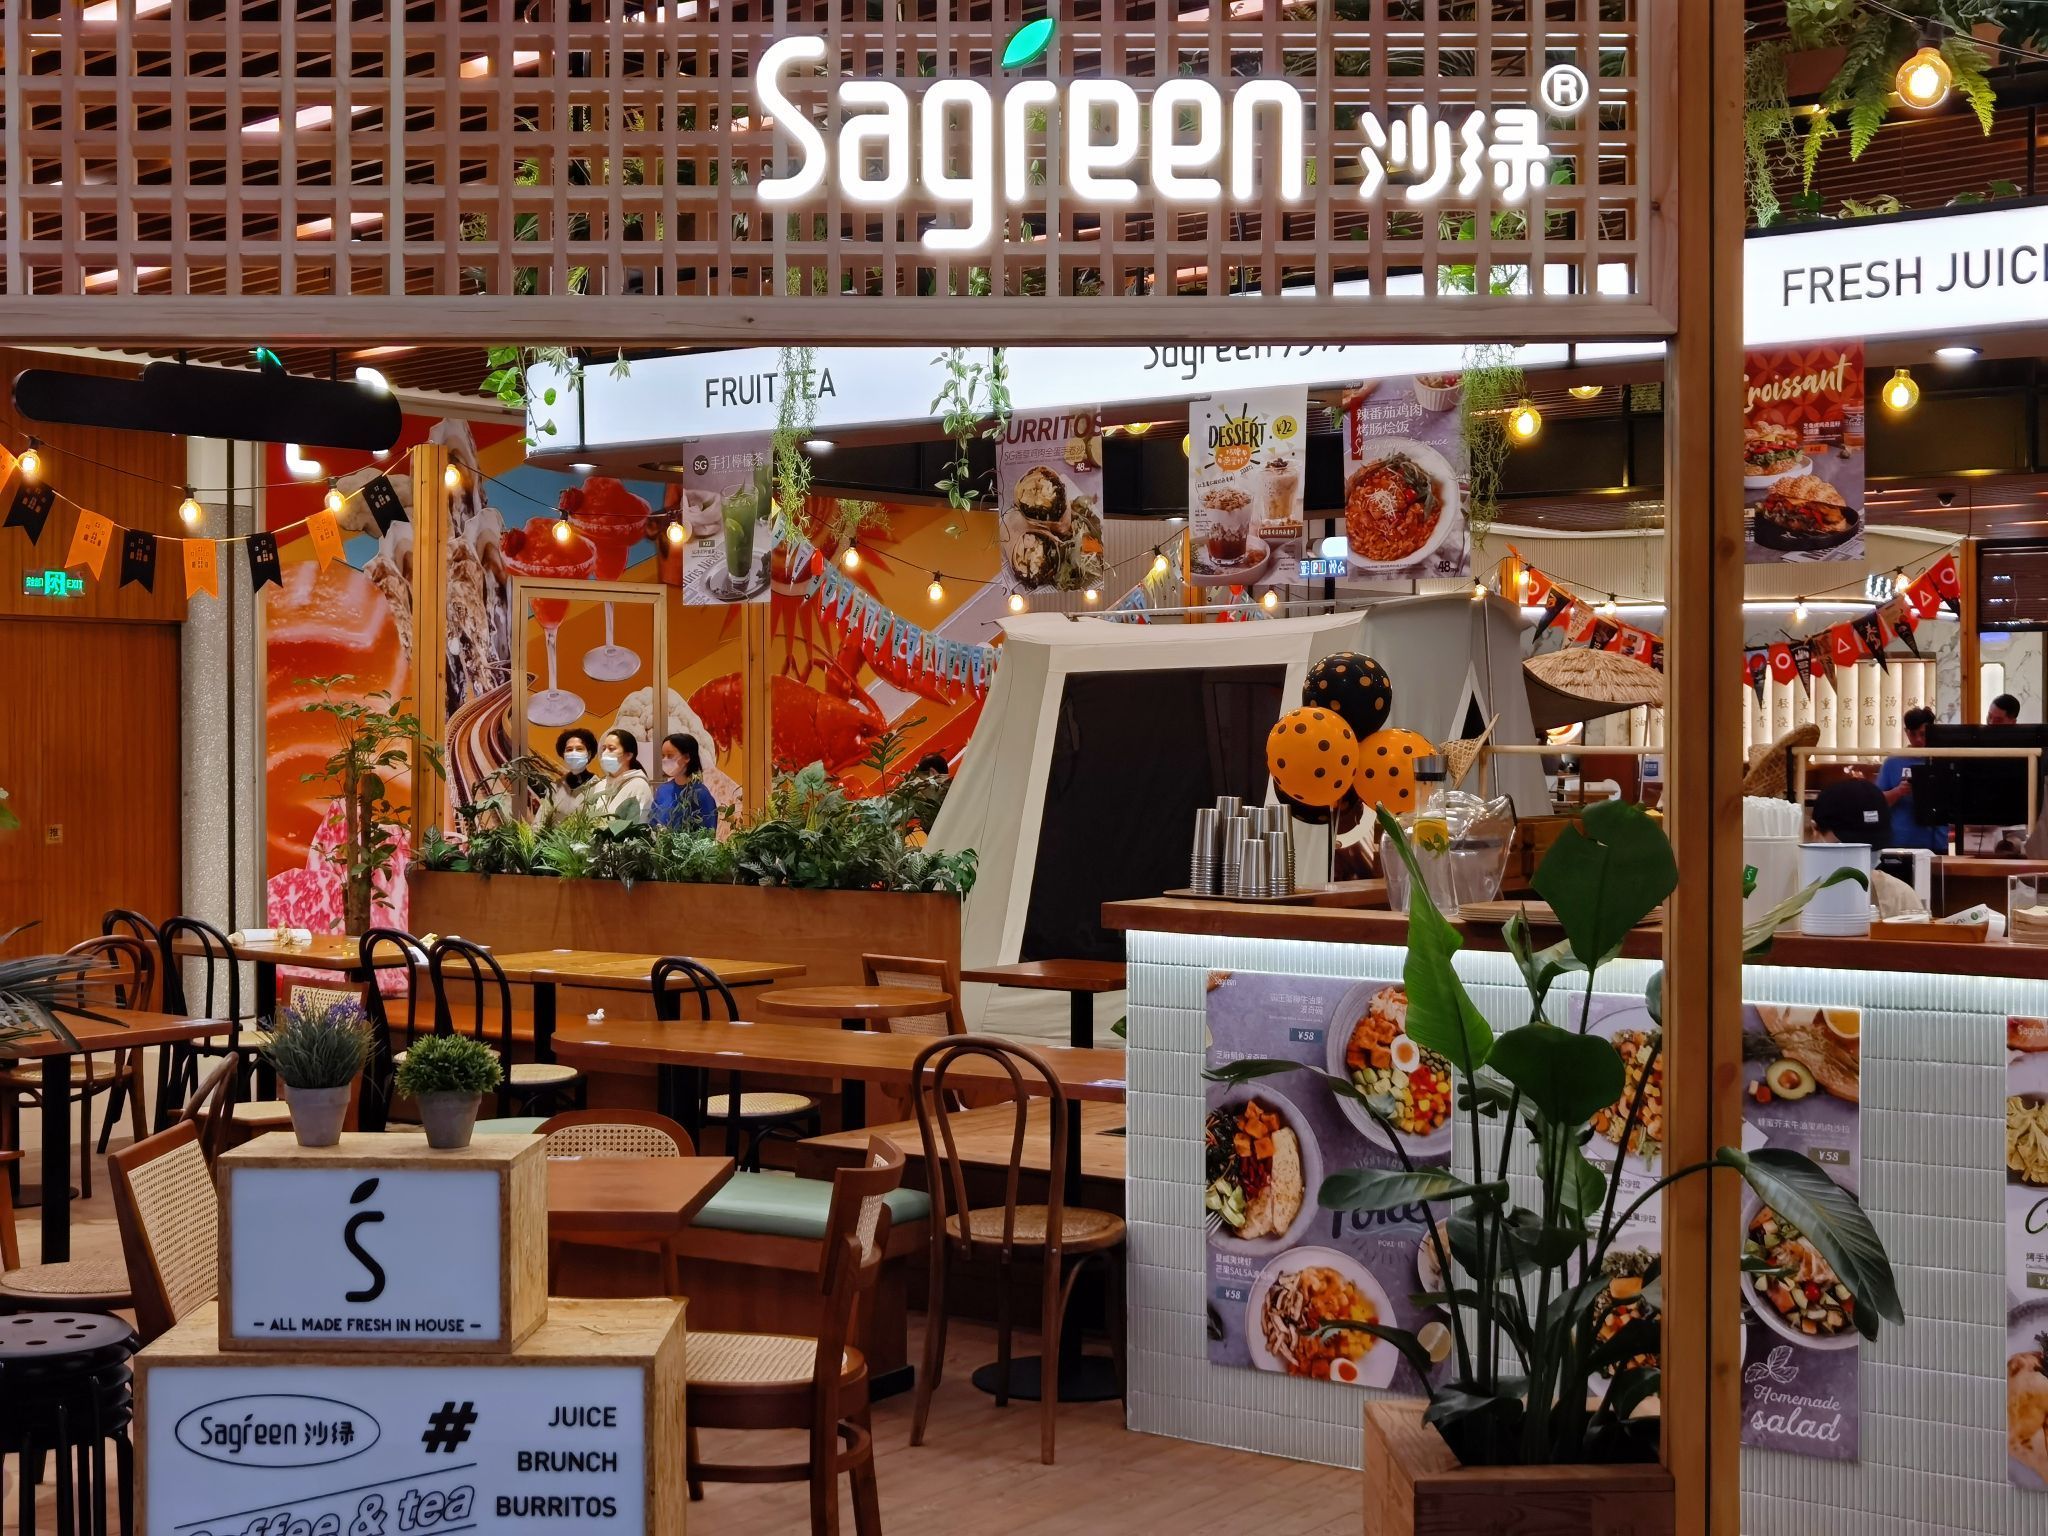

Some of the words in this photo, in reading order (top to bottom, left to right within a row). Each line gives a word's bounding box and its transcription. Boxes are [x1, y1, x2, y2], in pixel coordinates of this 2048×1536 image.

[757, 36, 1304, 250] Sagreen
[1359, 104, 1551, 200] 沙绿
[1783, 256, 1921, 307] FRESH
[1936, 243, 2048, 292] JUIC
[706, 372, 778, 408] FRUIT
[785, 367, 836, 399] TEA
[1357, 402, 1423, 421] 辣番茄鸡肉
[1208, 421, 1267, 449] DESSERT
[1356, 420, 1409, 438] 烤肠烩饭
[694, 460, 708, 471] SG
[1439, 560, 1451, 573] 48
[66, 579, 83, 589] EXIT
[1298, 1031, 1315, 1041] ¥58
[1819, 1151, 1839, 1161] ¥58
[1225, 1288, 1241, 1299] ¥58
[269, 1318, 297, 1331] ALL
[302, 1318, 342, 1331] MADE
[347, 1318, 391, 1332] FRESH
[396, 1318, 410, 1332] IN
[415, 1318, 464, 1332] HOUSE
[1753, 1384, 1841, 1411] Homemade
[548, 1406, 617, 1427] JUICE
[1750, 1406, 1842, 1442] salad
[201, 1415, 297, 1454] Sagreen
[304, 1420, 355, 1446] 沙绿
[517, 1451, 617, 1472] BRUNCH
[399, 1485, 475, 1531] tea
[496, 1496, 617, 1517] BURRITOS
